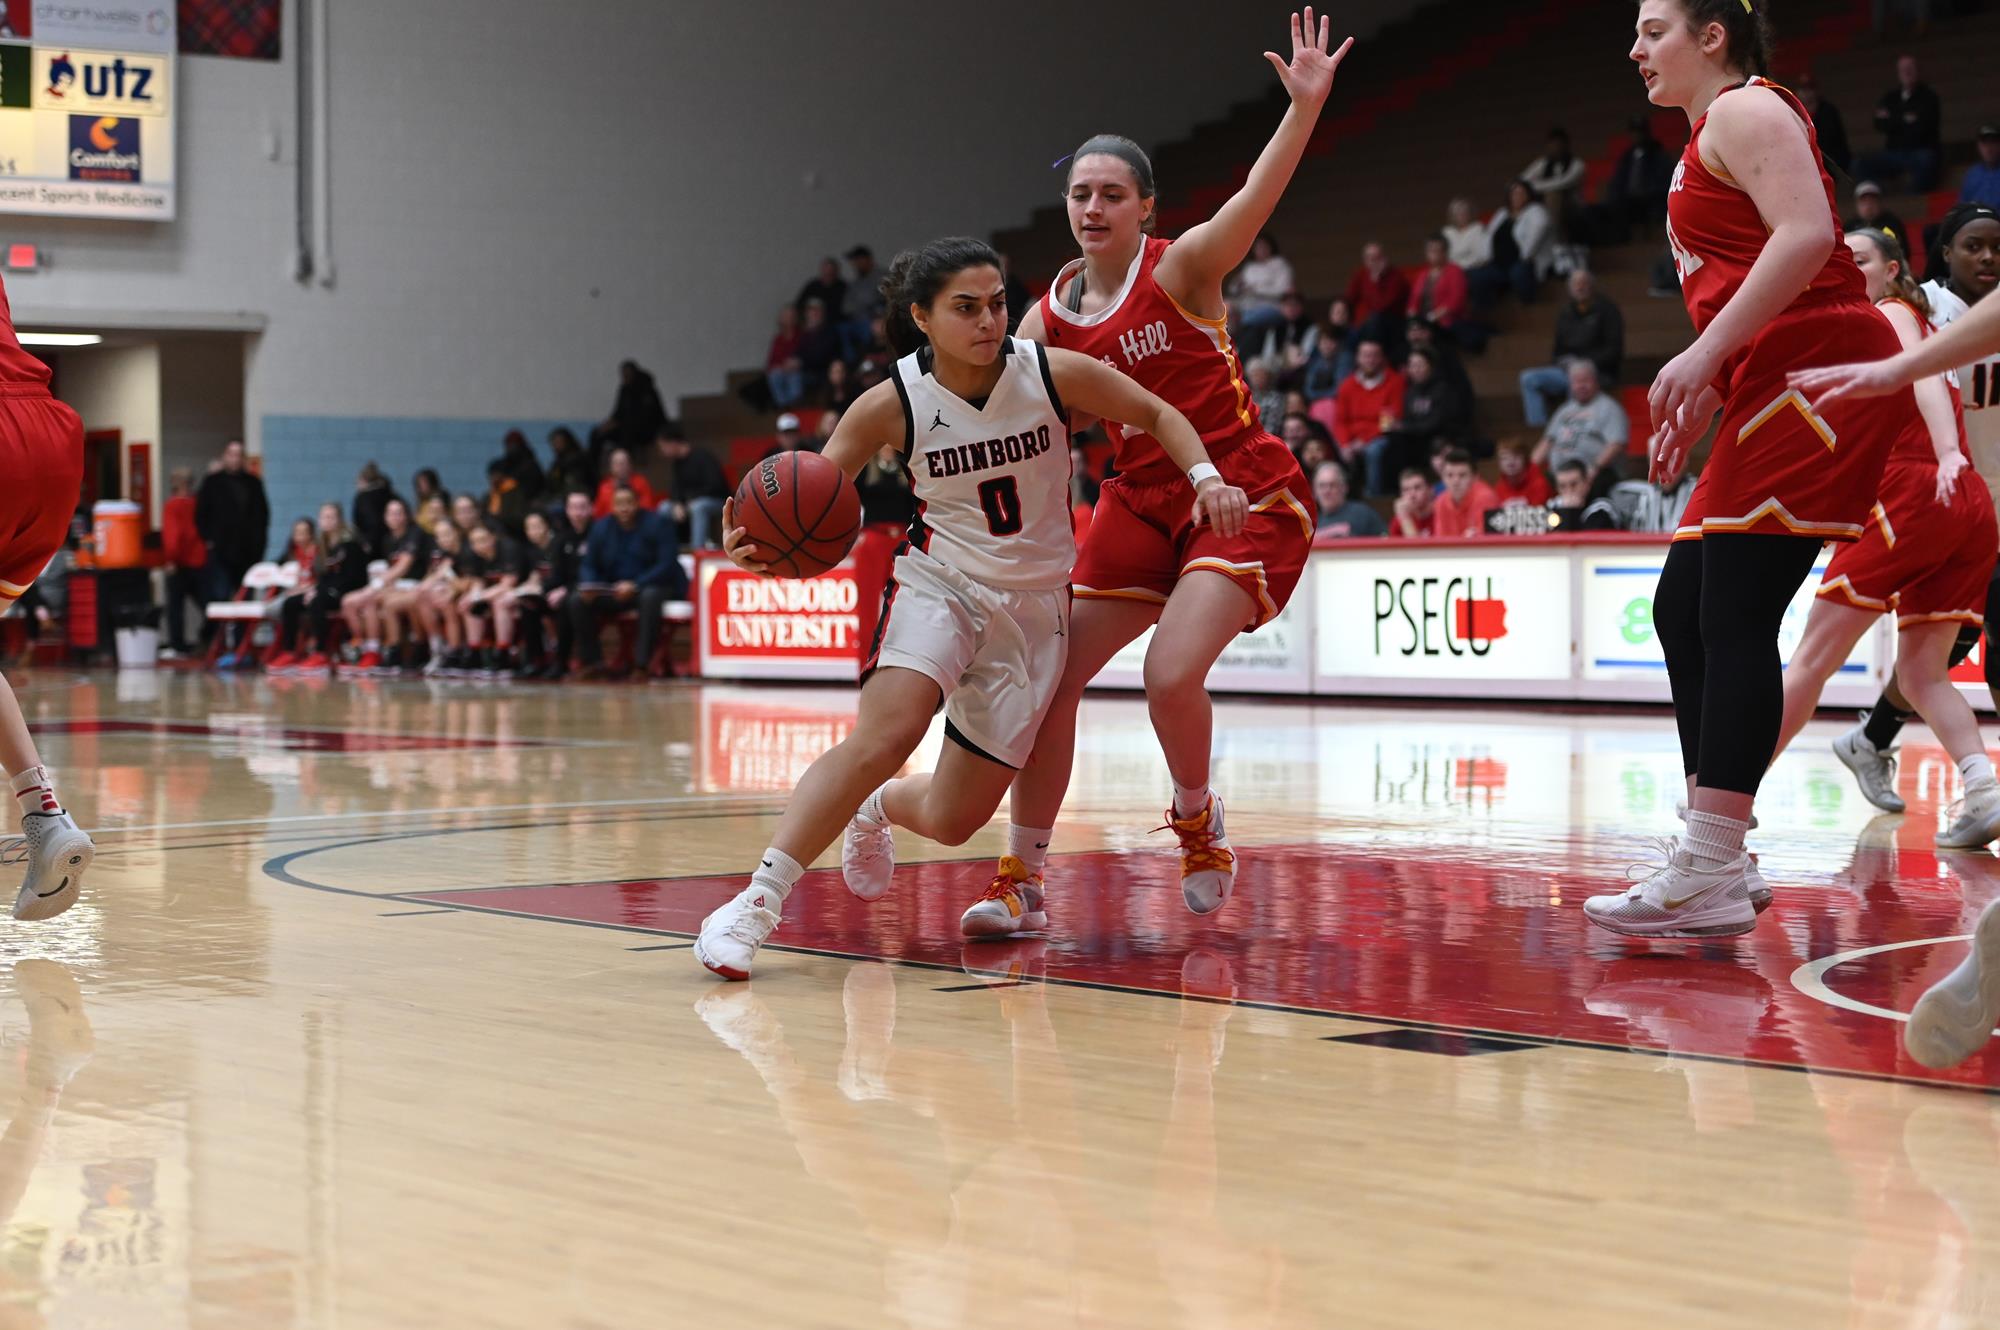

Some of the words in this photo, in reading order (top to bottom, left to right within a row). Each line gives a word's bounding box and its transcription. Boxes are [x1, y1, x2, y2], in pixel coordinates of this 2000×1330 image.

[41, 187, 90, 204] Sports
[95, 189, 164, 207] Medicine
[1119, 320, 1172, 366] Hill
[925, 424, 1050, 478] EDINBORO
[977, 475, 1023, 536] 0
[727, 578, 859, 612] EDINBORO
[1374, 577, 1493, 657] PSECU
